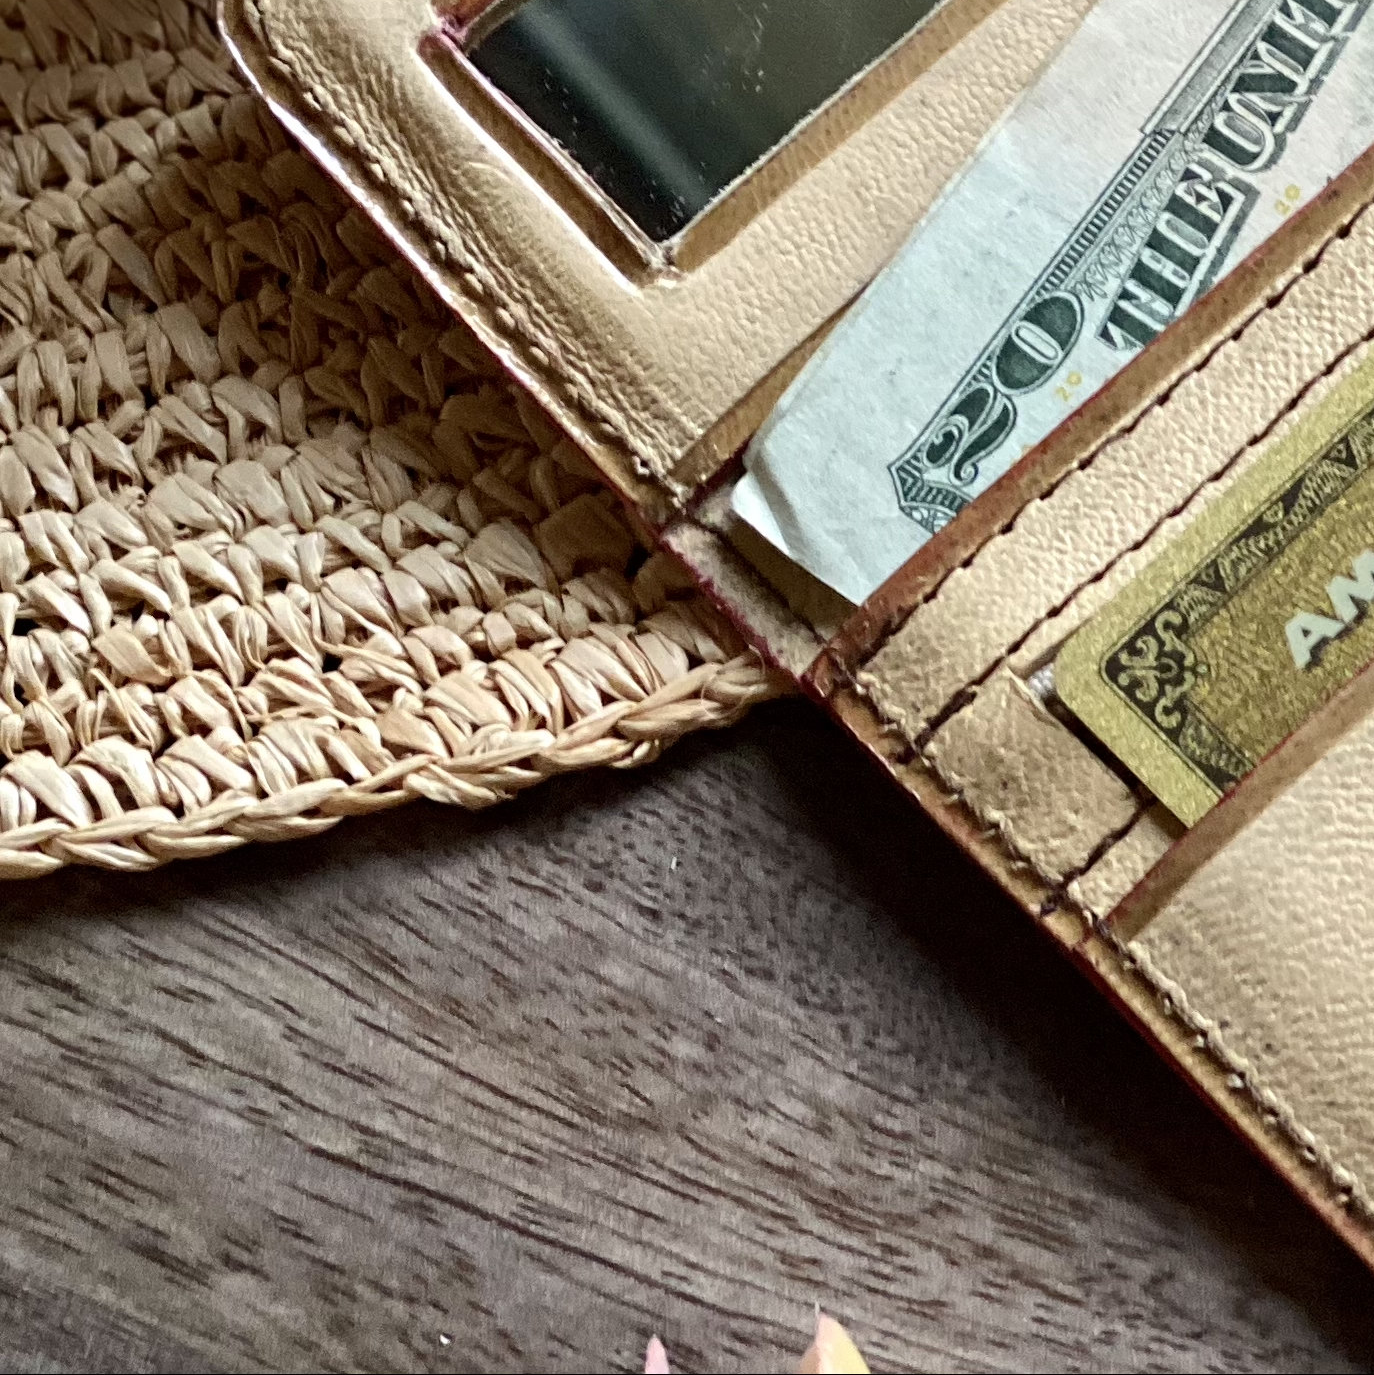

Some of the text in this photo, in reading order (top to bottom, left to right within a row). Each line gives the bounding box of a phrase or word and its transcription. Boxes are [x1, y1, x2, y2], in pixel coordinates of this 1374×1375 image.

[1096, 163, 1257, 351] THE
[922, 289, 1084, 486] 20
[1056, 370, 1083, 403] 20
